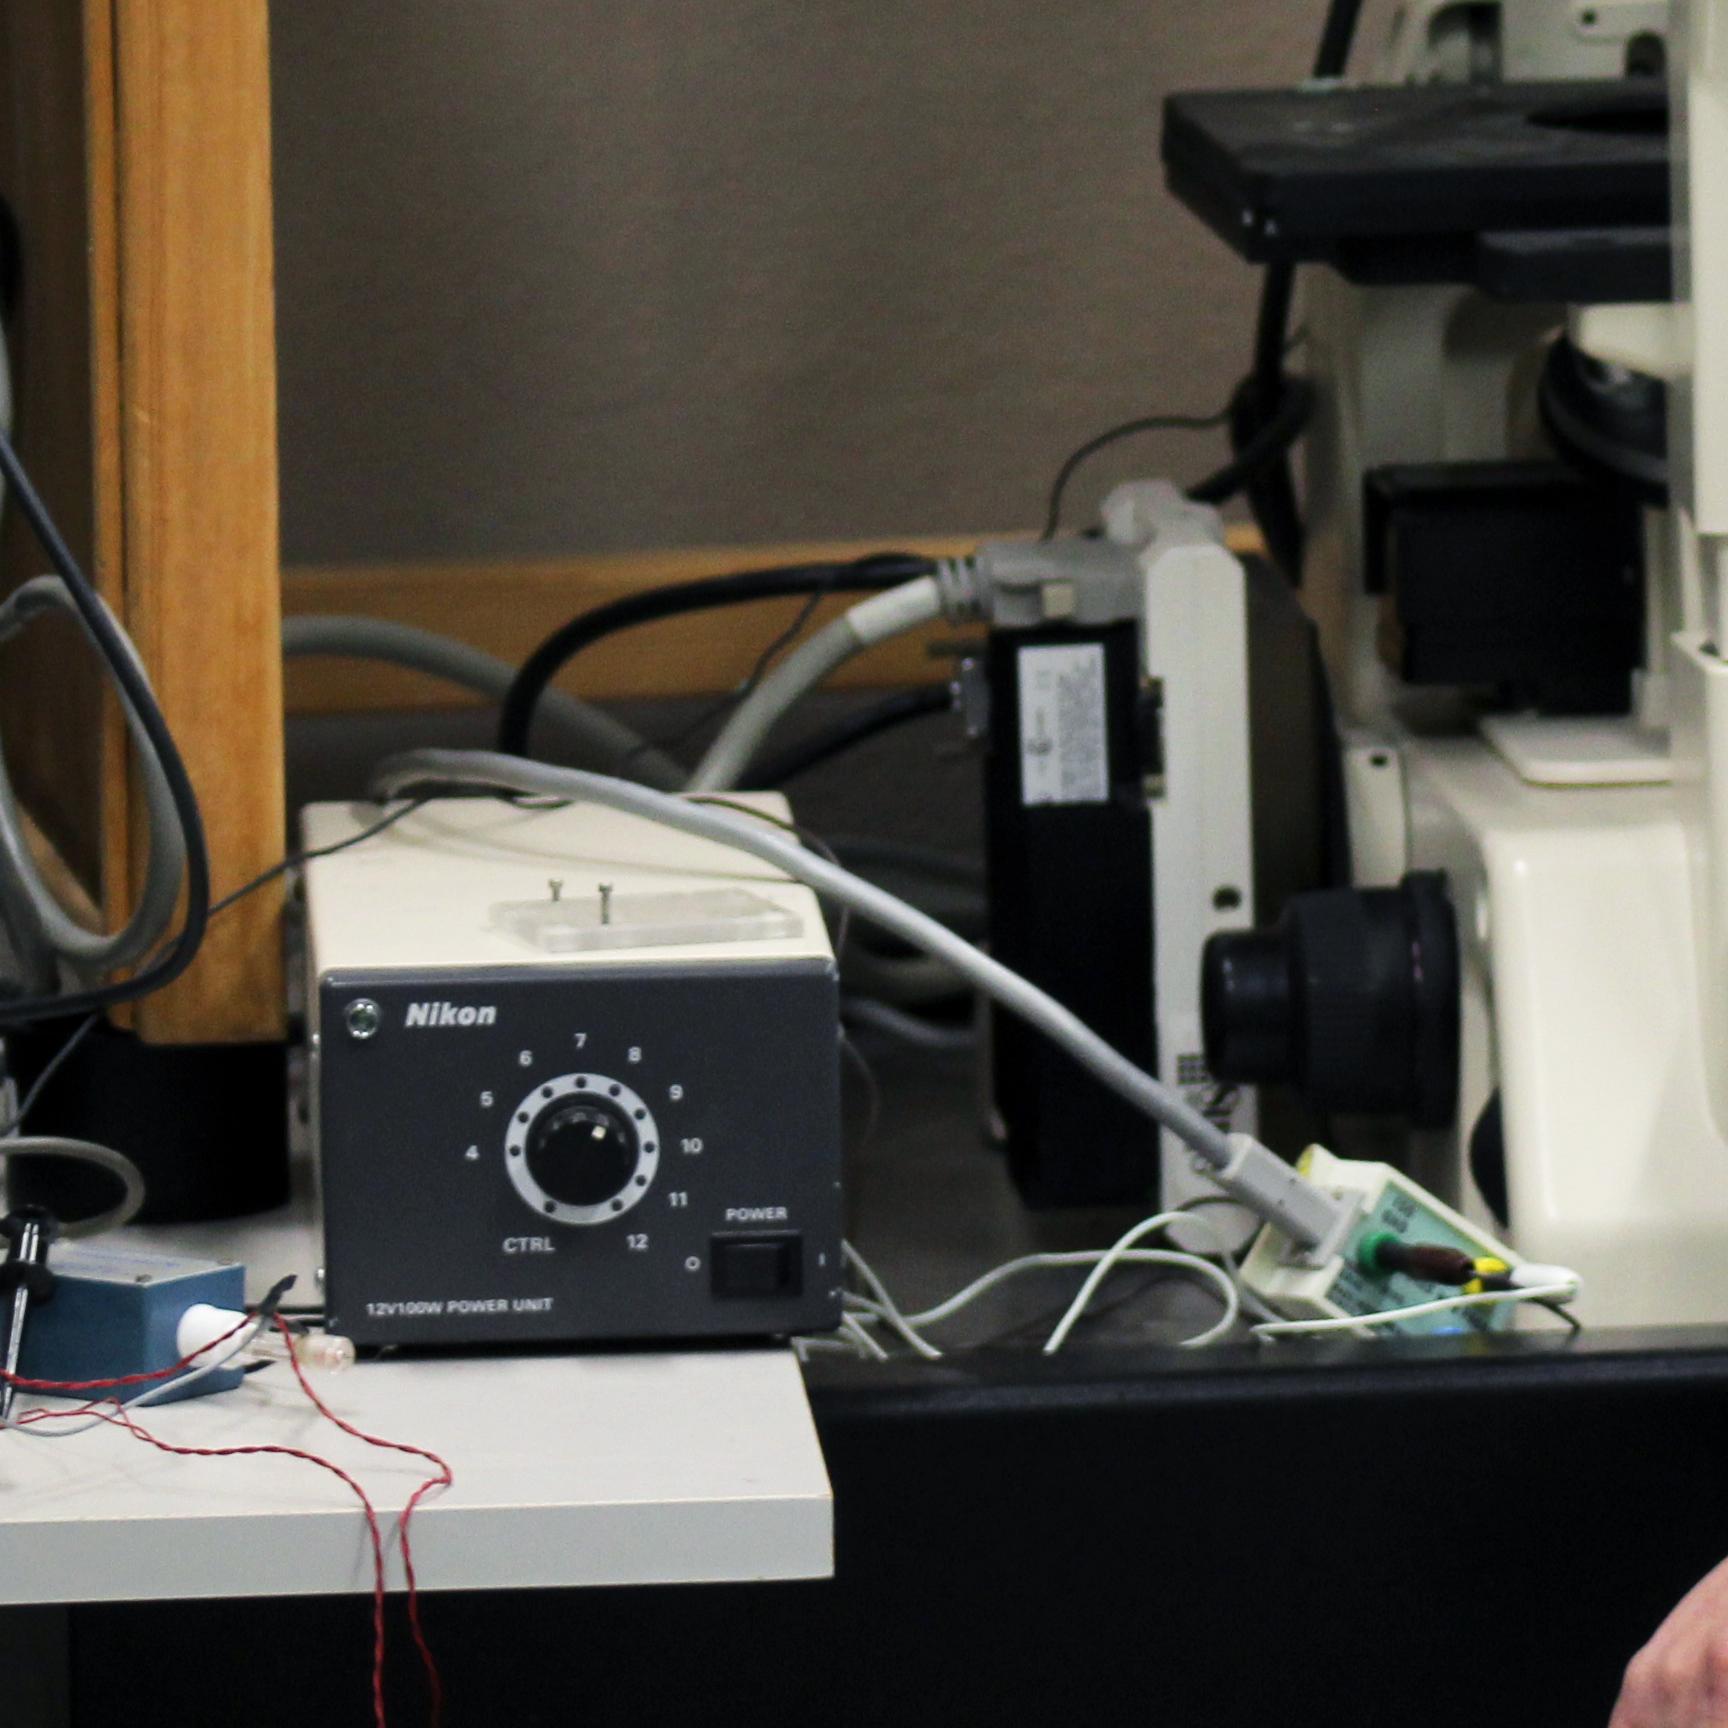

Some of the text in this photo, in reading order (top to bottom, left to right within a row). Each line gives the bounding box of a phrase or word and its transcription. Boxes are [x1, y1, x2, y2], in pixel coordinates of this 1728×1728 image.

[405, 1001, 497, 1027] Nikon
[574, 1032, 587, 1049] 7
[518, 1050, 533, 1066] 6
[627, 1046, 642, 1063] 8
[480, 1090, 494, 1107] 5
[669, 1084, 683, 1101] 9
[464, 1145, 480, 1161] 4
[681, 1138, 703, 1154] 10
[668, 1191, 688, 1207] 11
[725, 1206, 788, 1221] POWER
[503, 1236, 555, 1253] CTRL
[626, 1233, 649, 1250] 12
[366, 1297, 554, 1317] 12V100W POWER UNIT
